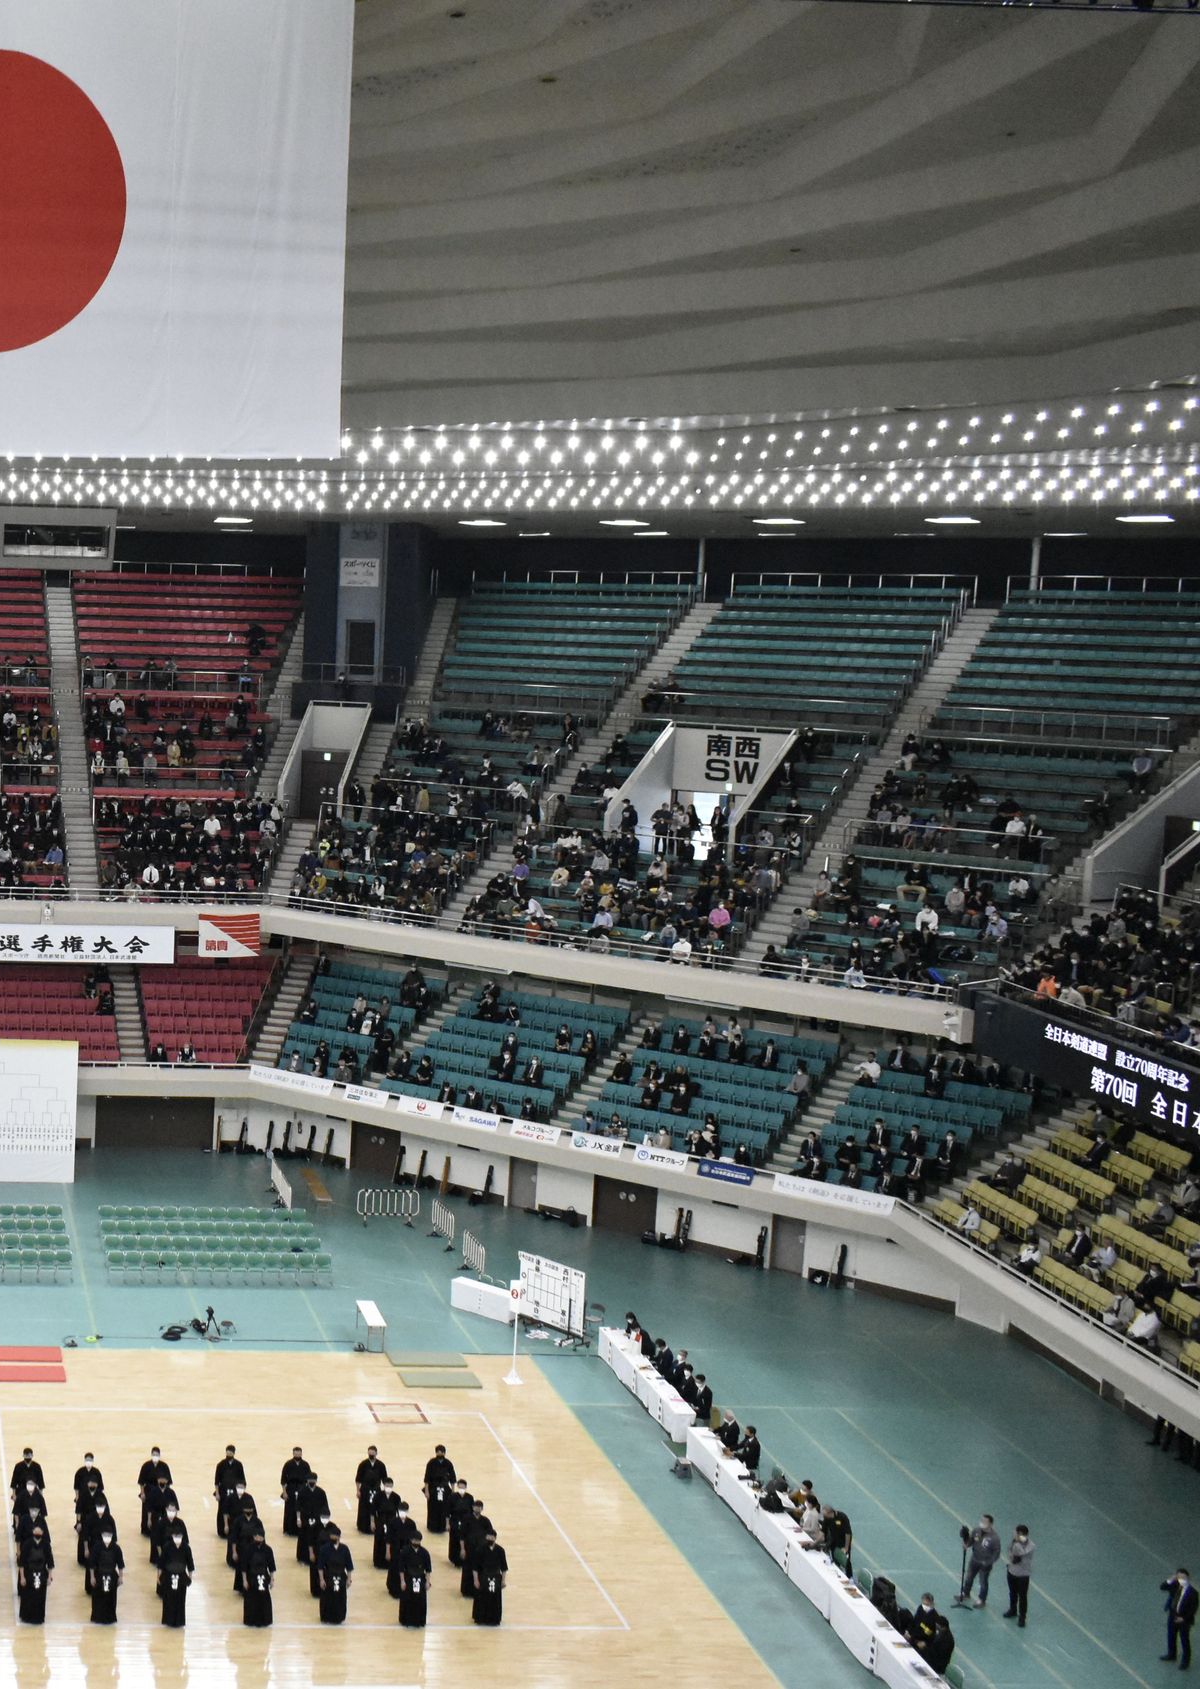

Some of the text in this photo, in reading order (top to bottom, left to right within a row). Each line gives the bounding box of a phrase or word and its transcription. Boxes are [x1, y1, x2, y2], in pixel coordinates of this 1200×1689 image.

[706, 734, 761, 759] 南西
[705, 759, 759, 784] SW
[1044, 1023, 1190, 1092] 全日本剣道連盟 設立70周年記念
[1090, 1067, 1137, 1107] 第70回
